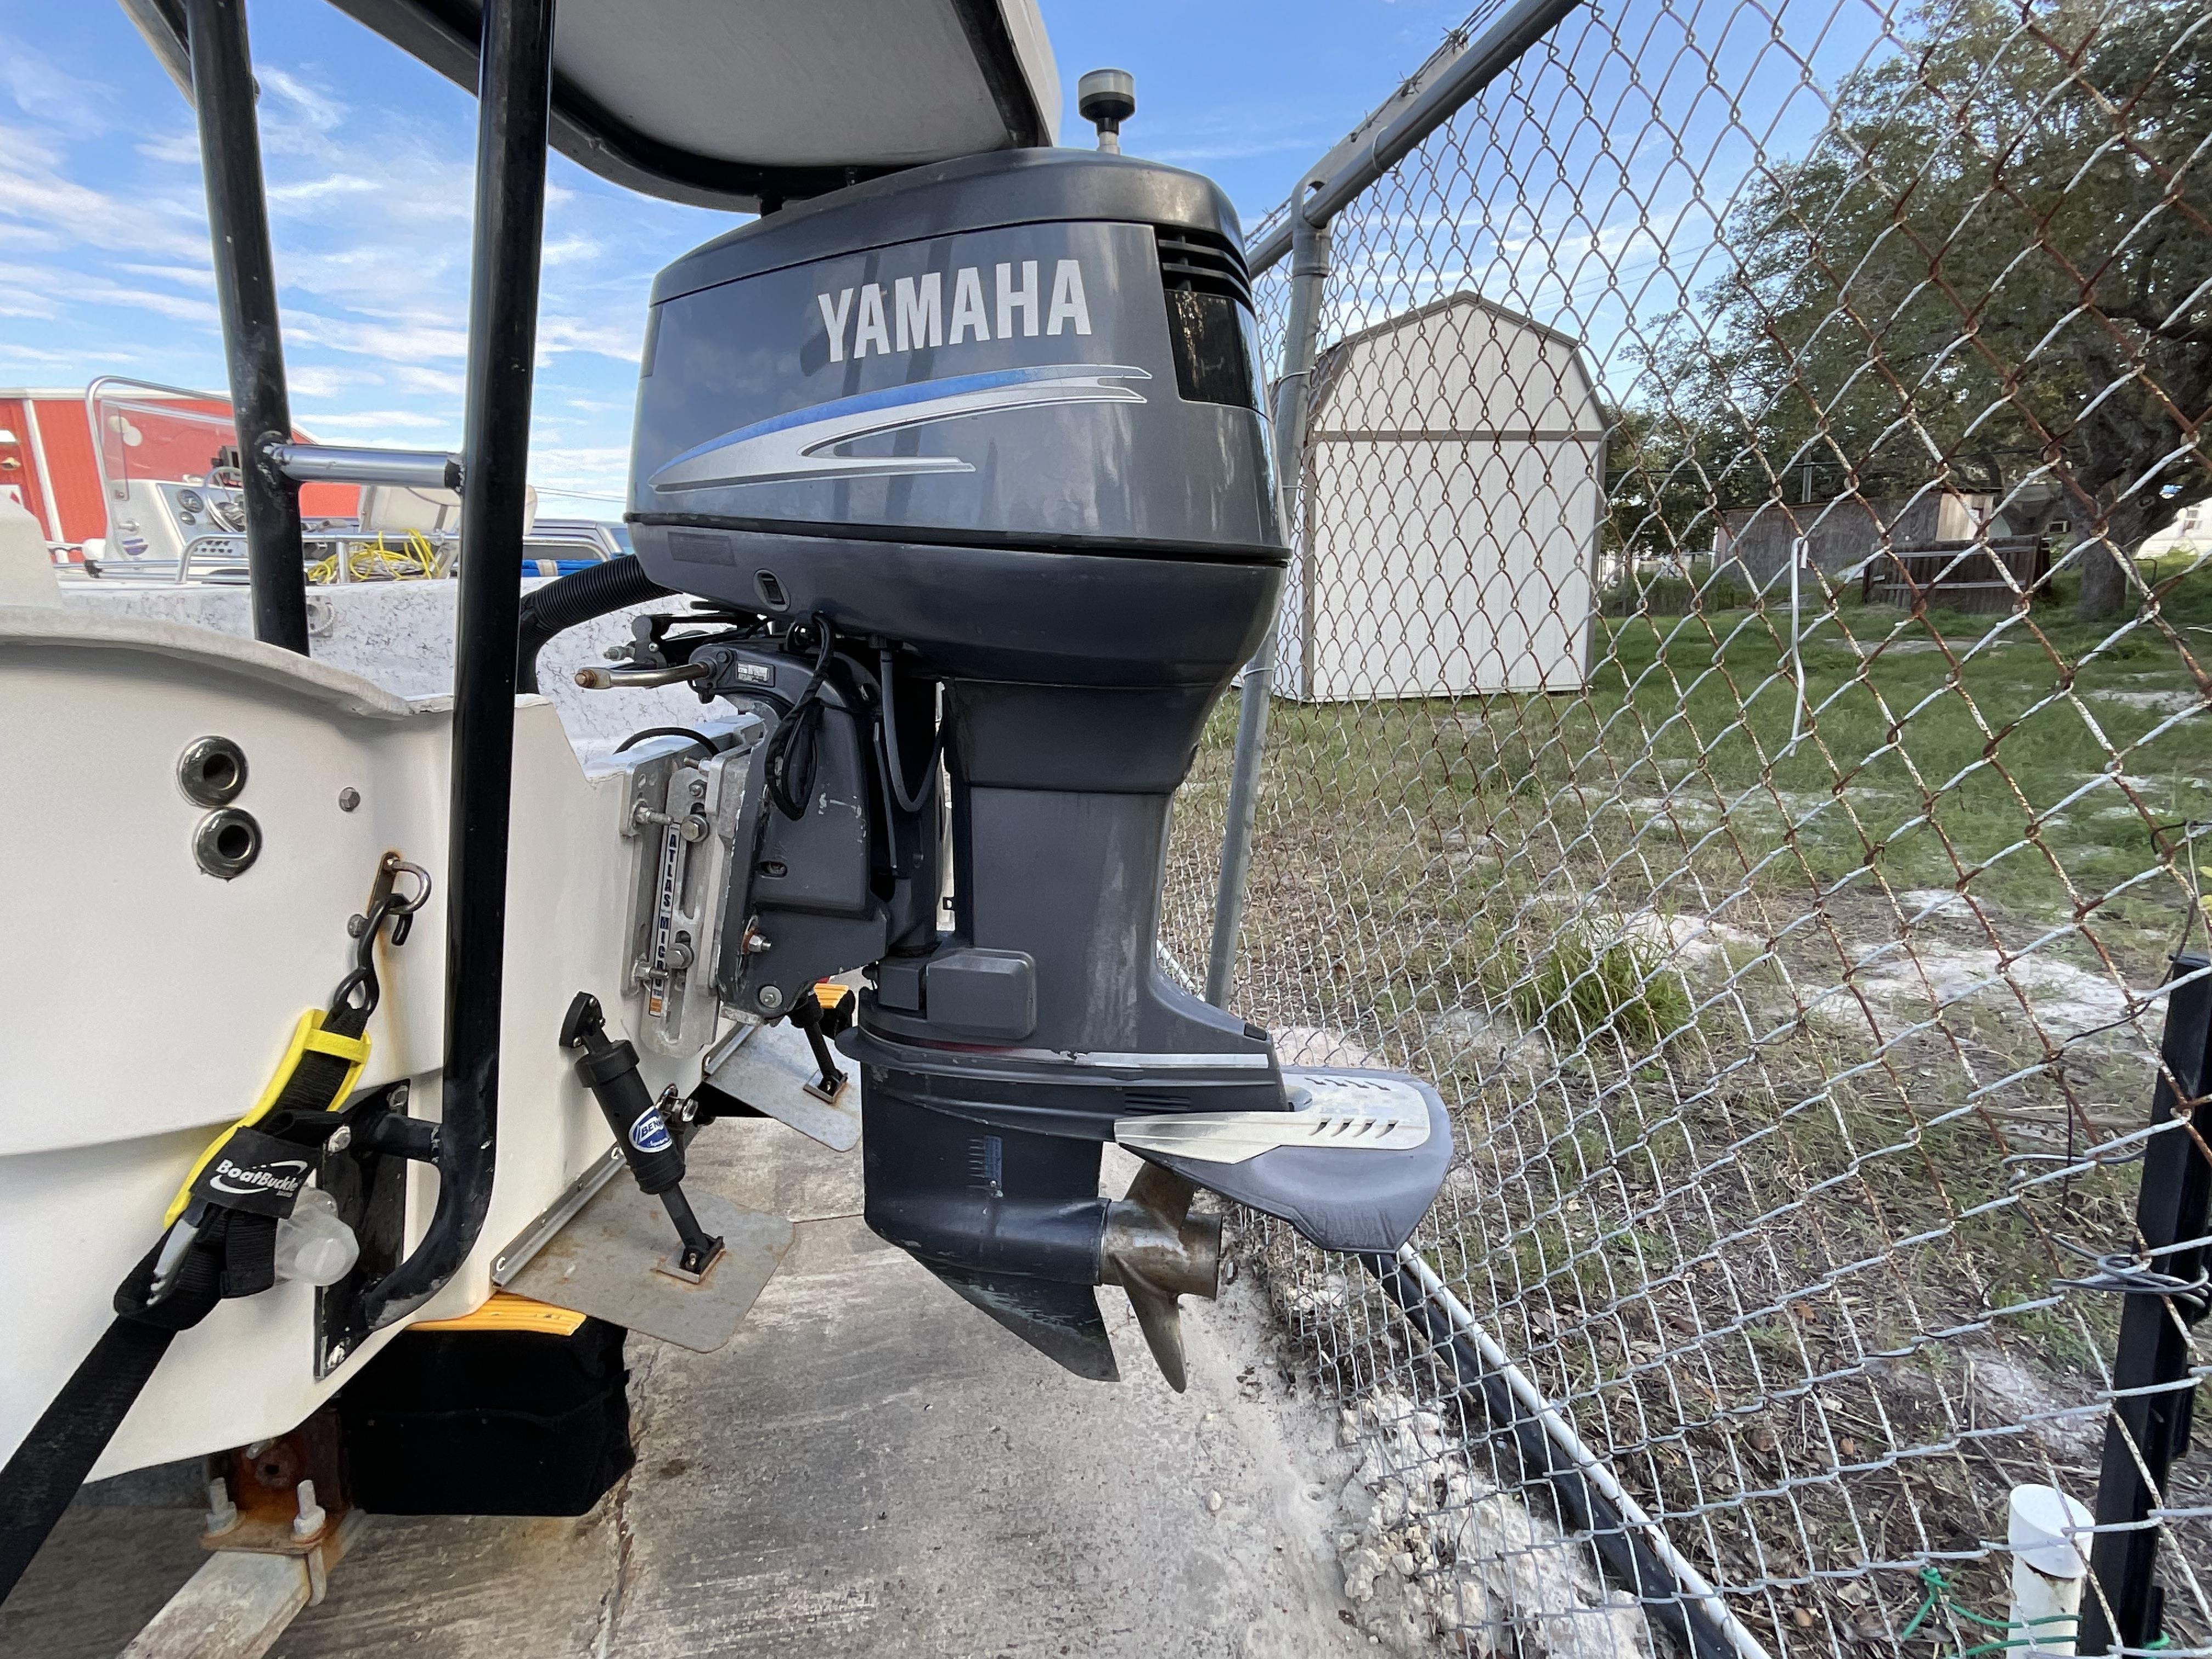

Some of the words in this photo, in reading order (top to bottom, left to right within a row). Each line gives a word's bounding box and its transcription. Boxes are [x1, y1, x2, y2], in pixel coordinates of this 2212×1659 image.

[817, 259, 1092, 363] YAMAHA
[663, 834, 677, 907] ATLAS
[215, 1159, 299, 1192] BoatBuckle
